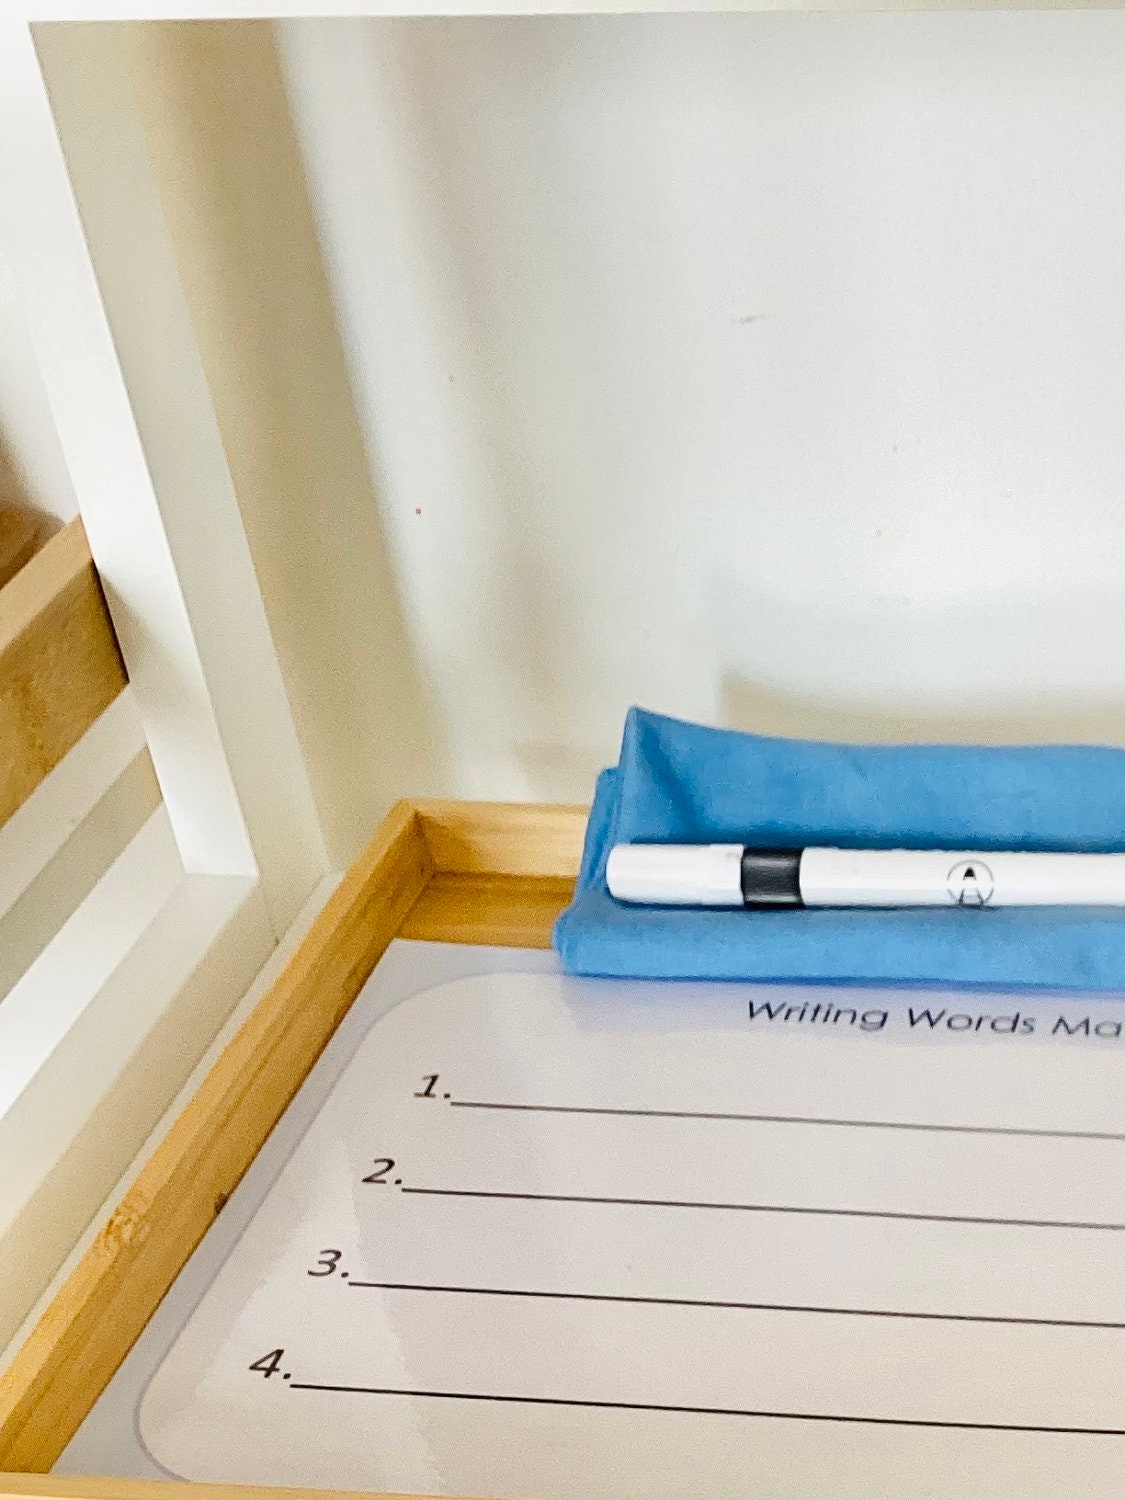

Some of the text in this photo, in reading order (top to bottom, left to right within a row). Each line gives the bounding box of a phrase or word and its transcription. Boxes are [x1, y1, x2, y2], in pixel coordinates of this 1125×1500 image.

[747, 1000, 889, 1032] Writing
[907, 1007, 1036, 1035] Words
[412, 1074, 452, 1100] 1.
[361, 1158, 403, 1185] 2.
[306, 1249, 351, 1279] 3.
[249, 1348, 292, 1380] 4.
